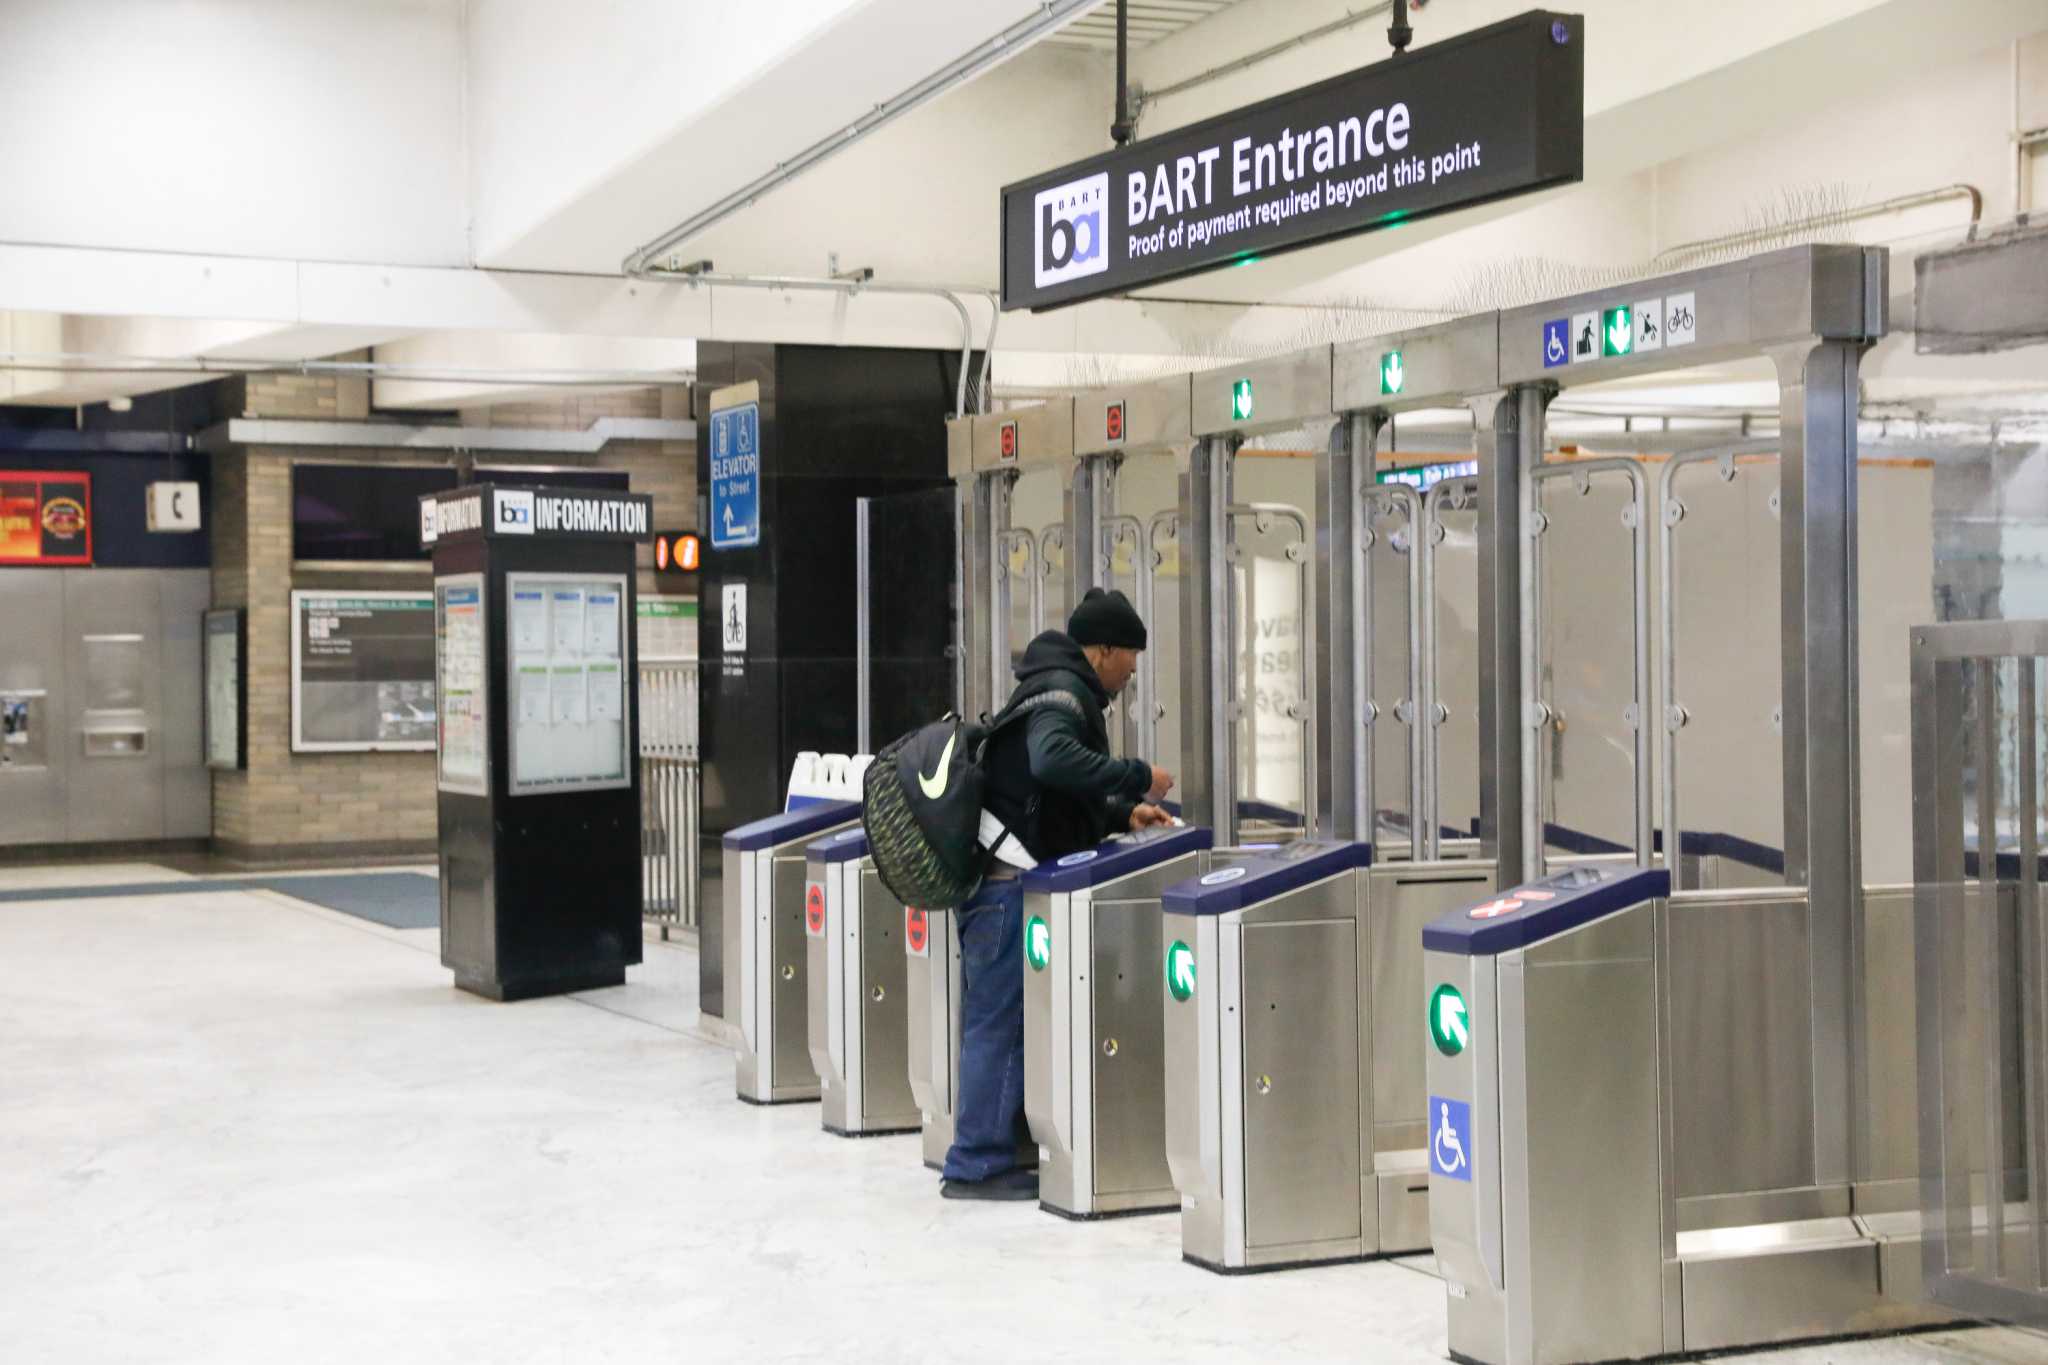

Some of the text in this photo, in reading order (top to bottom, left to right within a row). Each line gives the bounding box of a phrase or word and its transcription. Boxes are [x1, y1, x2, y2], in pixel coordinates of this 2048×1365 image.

[1128, 101, 1411, 226] BART Entrance
[1058, 187, 1101, 211] BART
[1128, 141, 1481, 258] Proof of payment required beyond this point
[713, 454, 756, 480] ELEVATOR
[719, 480, 750, 497] to Street
[536, 497, 647, 534] INFORMATION
